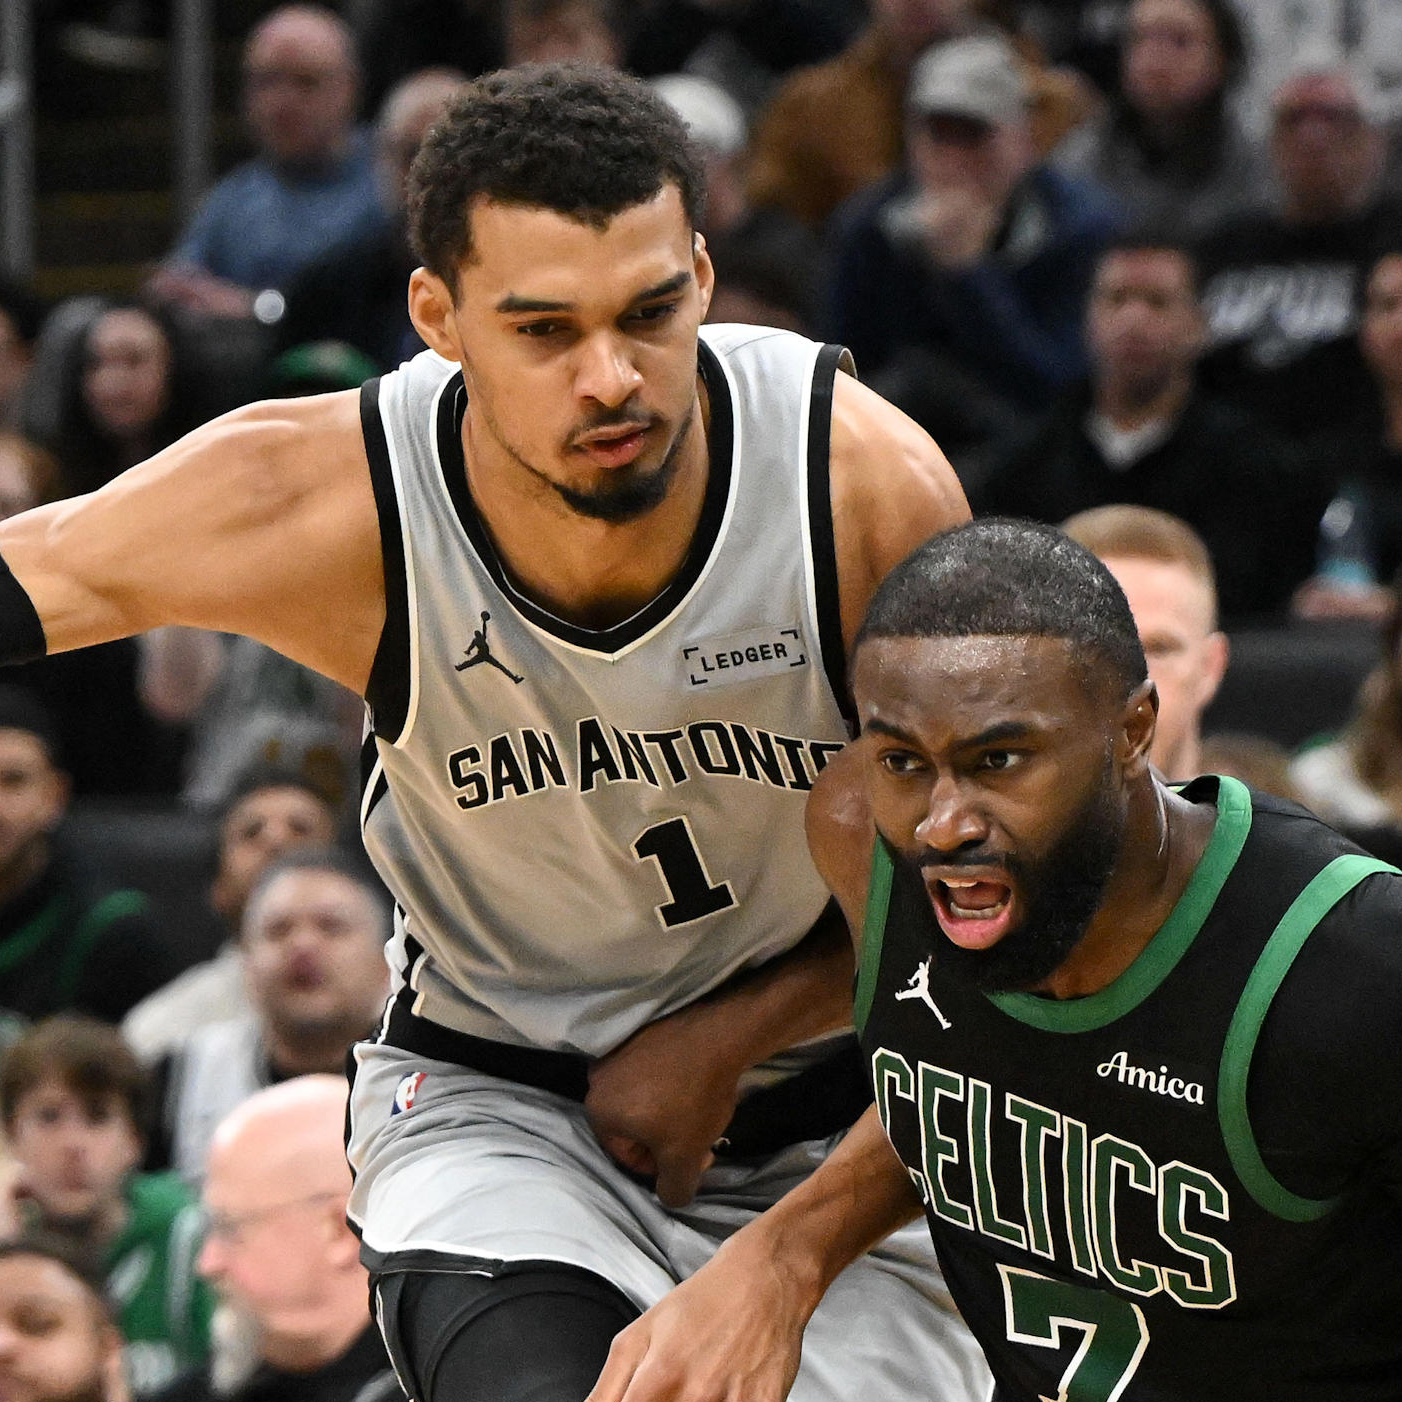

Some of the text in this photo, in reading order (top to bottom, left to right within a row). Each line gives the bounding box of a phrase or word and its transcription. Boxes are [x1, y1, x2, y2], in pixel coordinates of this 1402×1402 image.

[700, 642, 788, 672] LEDGER
[447, 728, 570, 811] SAN
[629, 814, 741, 933] 1
[1096, 1050, 1206, 1106] Amica
[871, 1046, 1238, 1310] CELTICS
